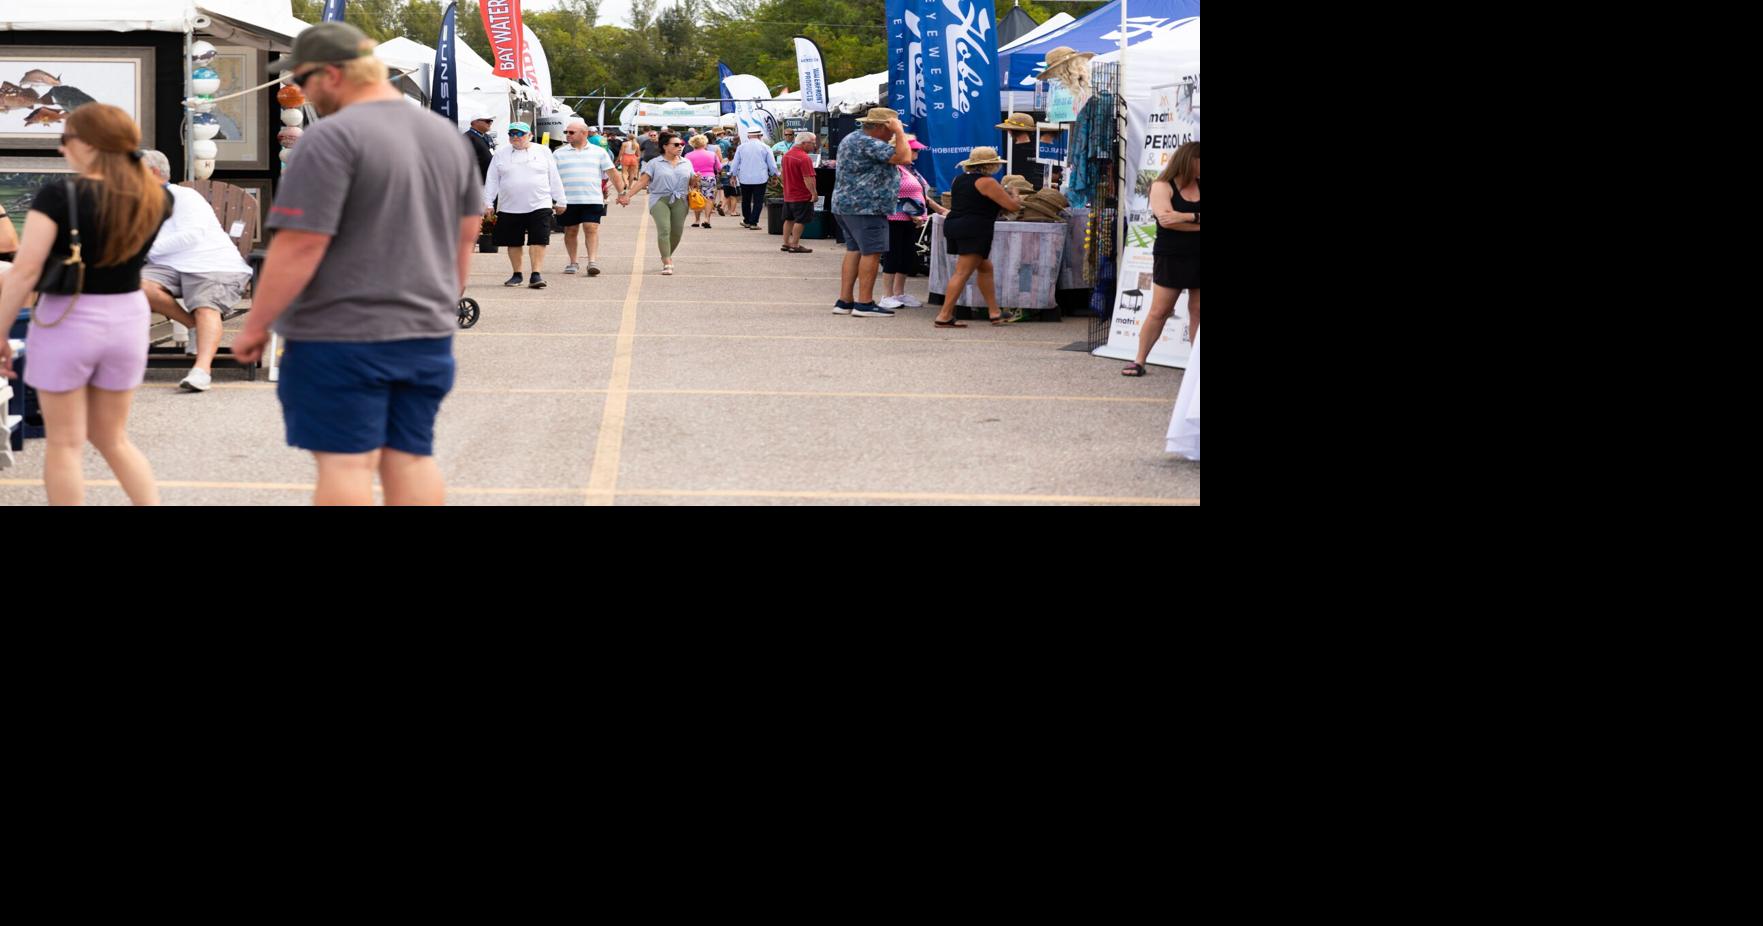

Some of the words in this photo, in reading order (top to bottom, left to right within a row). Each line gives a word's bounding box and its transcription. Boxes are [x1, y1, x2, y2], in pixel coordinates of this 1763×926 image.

[498, 47, 515, 70] BAY
[893, 18, 905, 116] EYEWEAR
[1144, 132, 1192, 149] PERGOLAS
